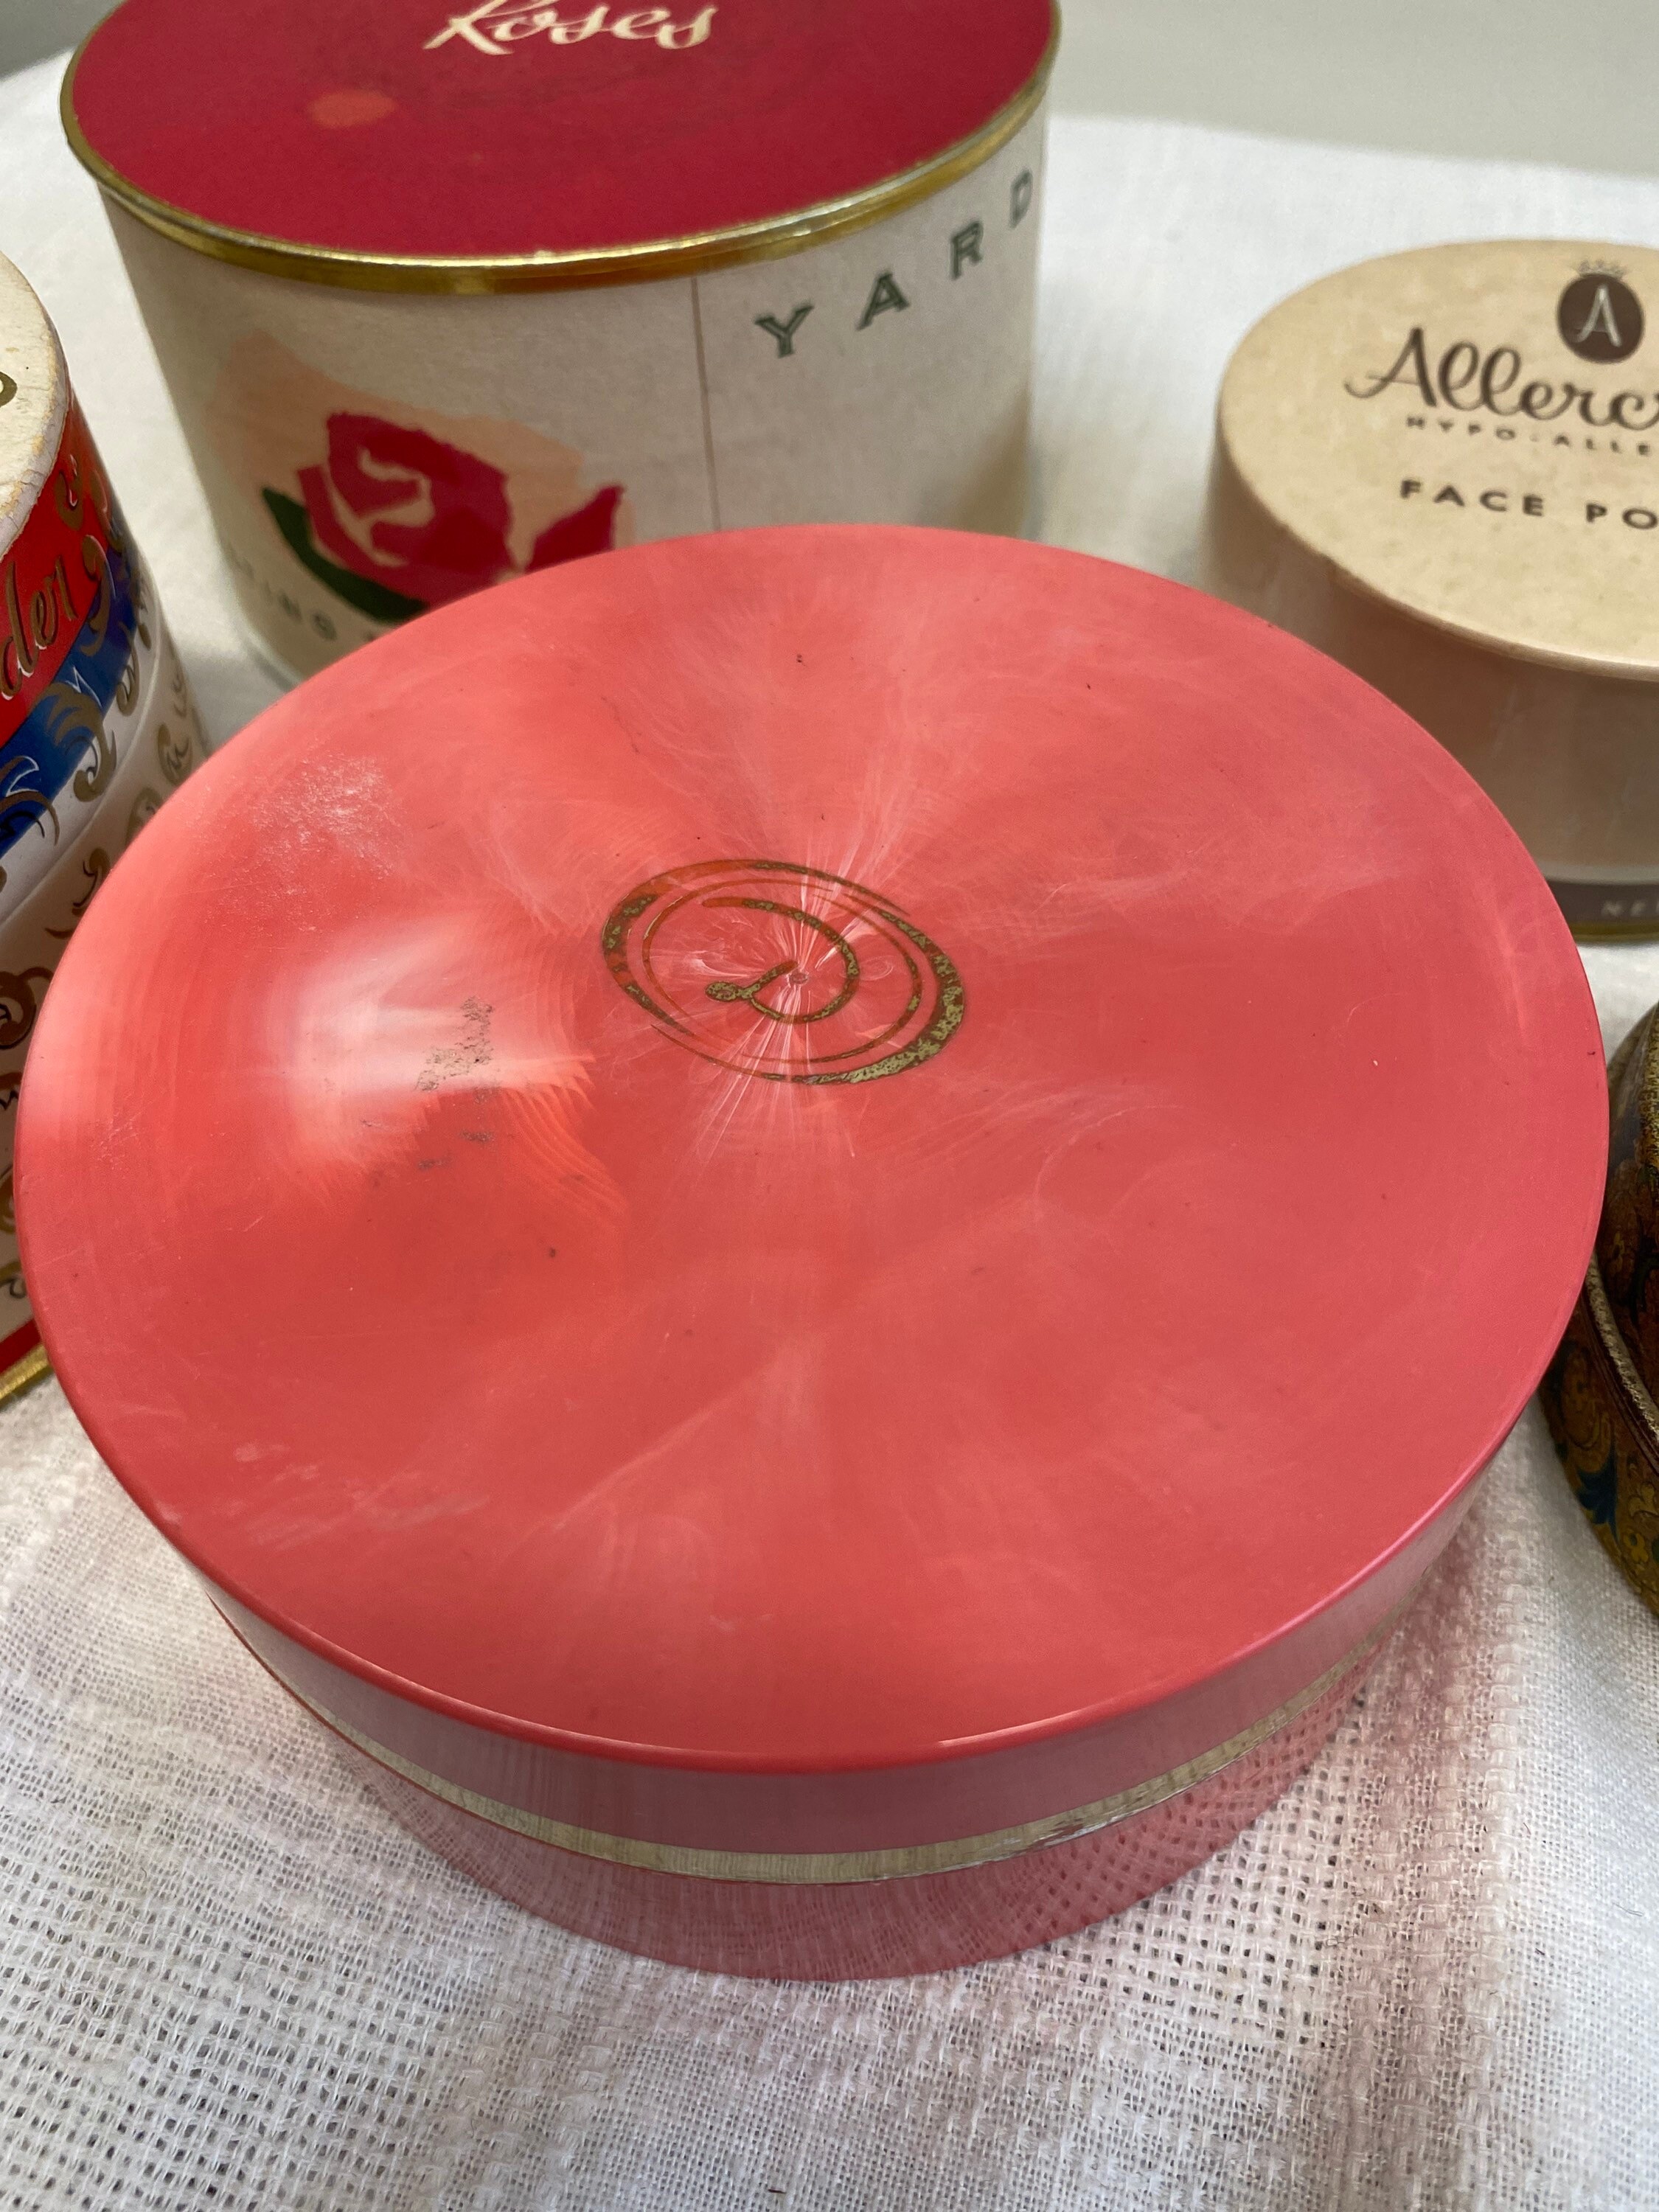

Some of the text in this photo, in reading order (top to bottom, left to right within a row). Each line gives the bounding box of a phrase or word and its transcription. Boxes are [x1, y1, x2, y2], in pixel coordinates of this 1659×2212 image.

[1572, 283, 1622, 348] A
[1343, 327, 1659, 431] Allerc
[1399, 479, 1659, 531] FACE PO
